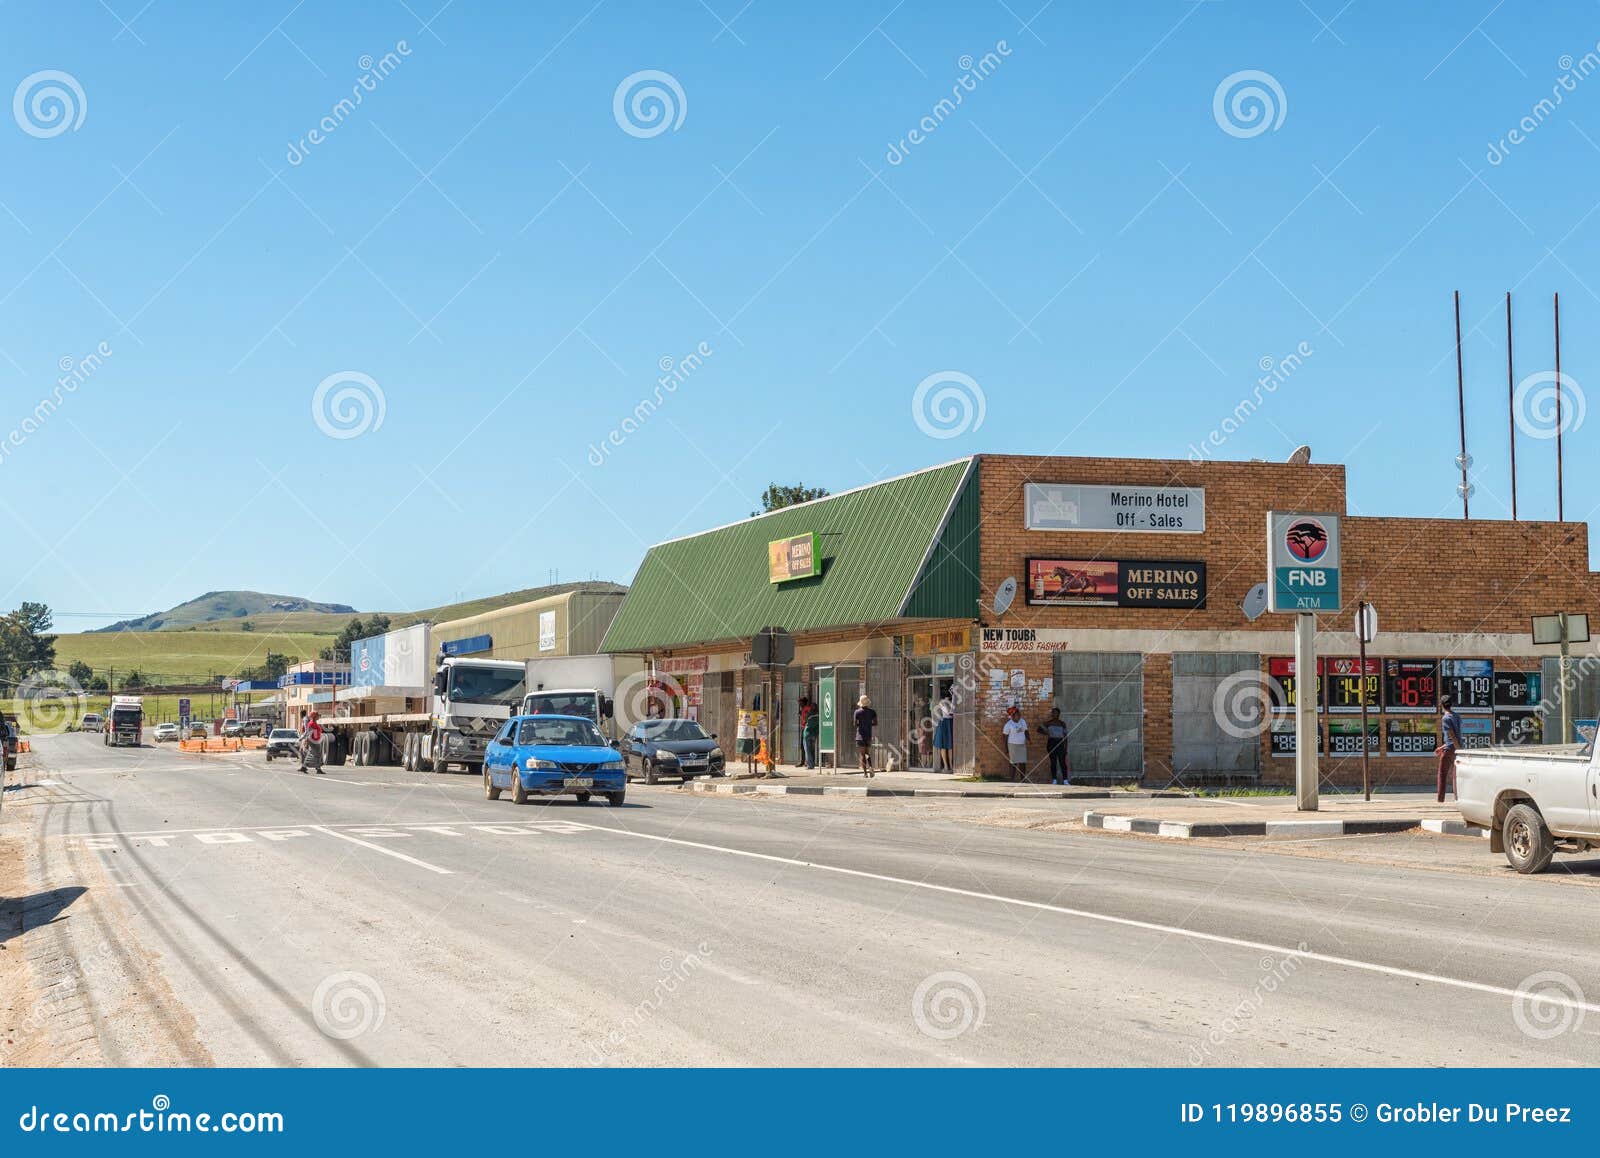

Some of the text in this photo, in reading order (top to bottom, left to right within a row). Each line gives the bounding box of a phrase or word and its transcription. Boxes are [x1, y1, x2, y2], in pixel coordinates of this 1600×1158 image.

[1111, 492, 1189, 508] Merino Hotel
[1116, 512, 1134, 527] Off
[1150, 514, 1183, 528] Sales
[1127, 569, 1198, 584] MERINO
[1288, 570, 1327, 587] FNB
[1127, 588, 1198, 600] OFF SALES
[1296, 597, 1320, 608] ATM
[983, 629, 1036, 641] NEW TOUBA
[347, 825, 593, 838] STOP
[84, 830, 311, 850] STOP
